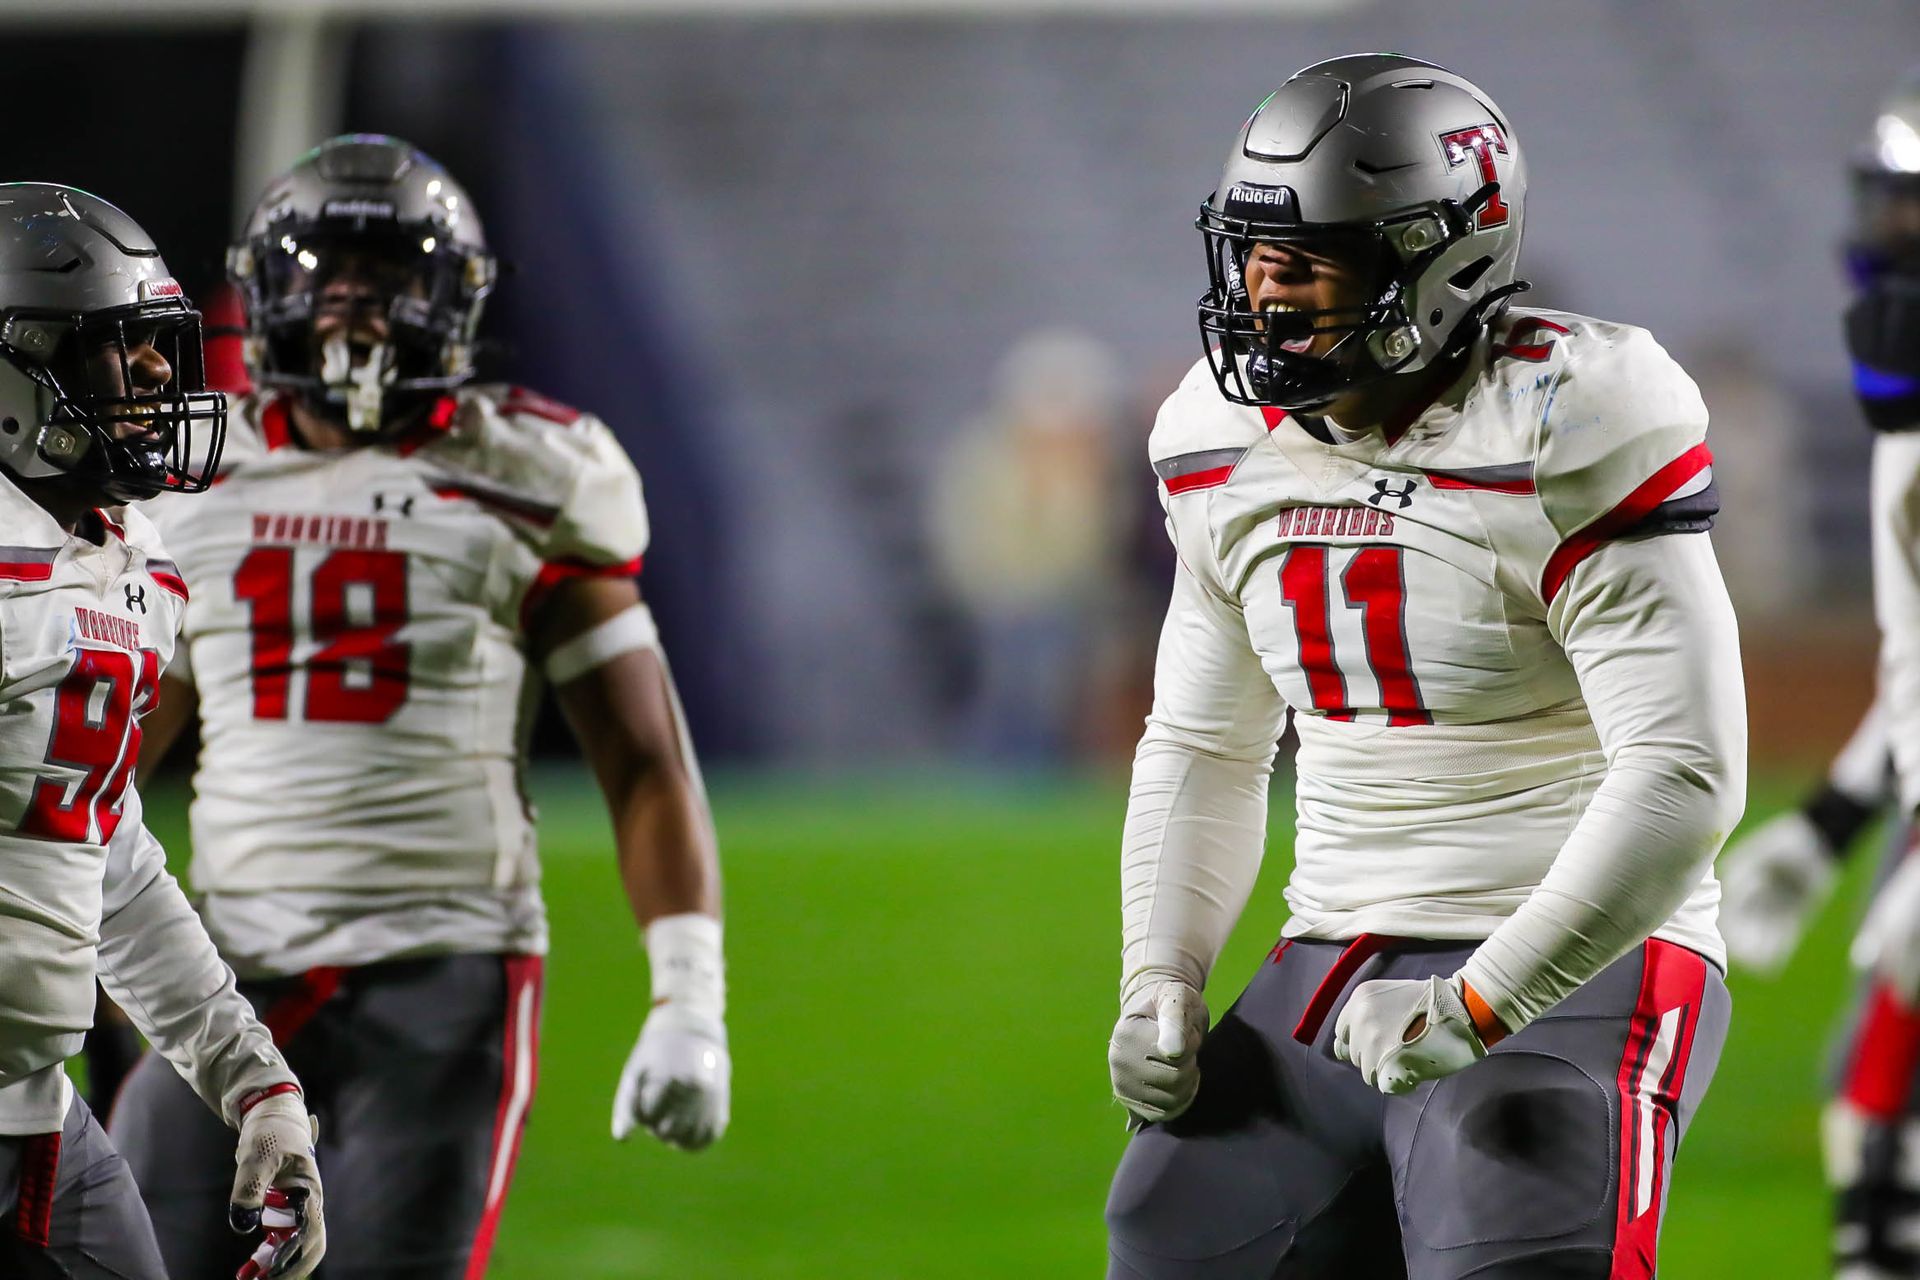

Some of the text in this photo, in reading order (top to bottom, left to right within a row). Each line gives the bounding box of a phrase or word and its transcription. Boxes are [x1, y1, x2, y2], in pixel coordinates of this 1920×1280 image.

[1437, 122, 1509, 233] T
[1277, 506, 1396, 537] WARRIORS
[75, 606, 140, 652] WARRIORS
[233, 546, 411, 724] 18
[1277, 543, 1434, 727] 11
